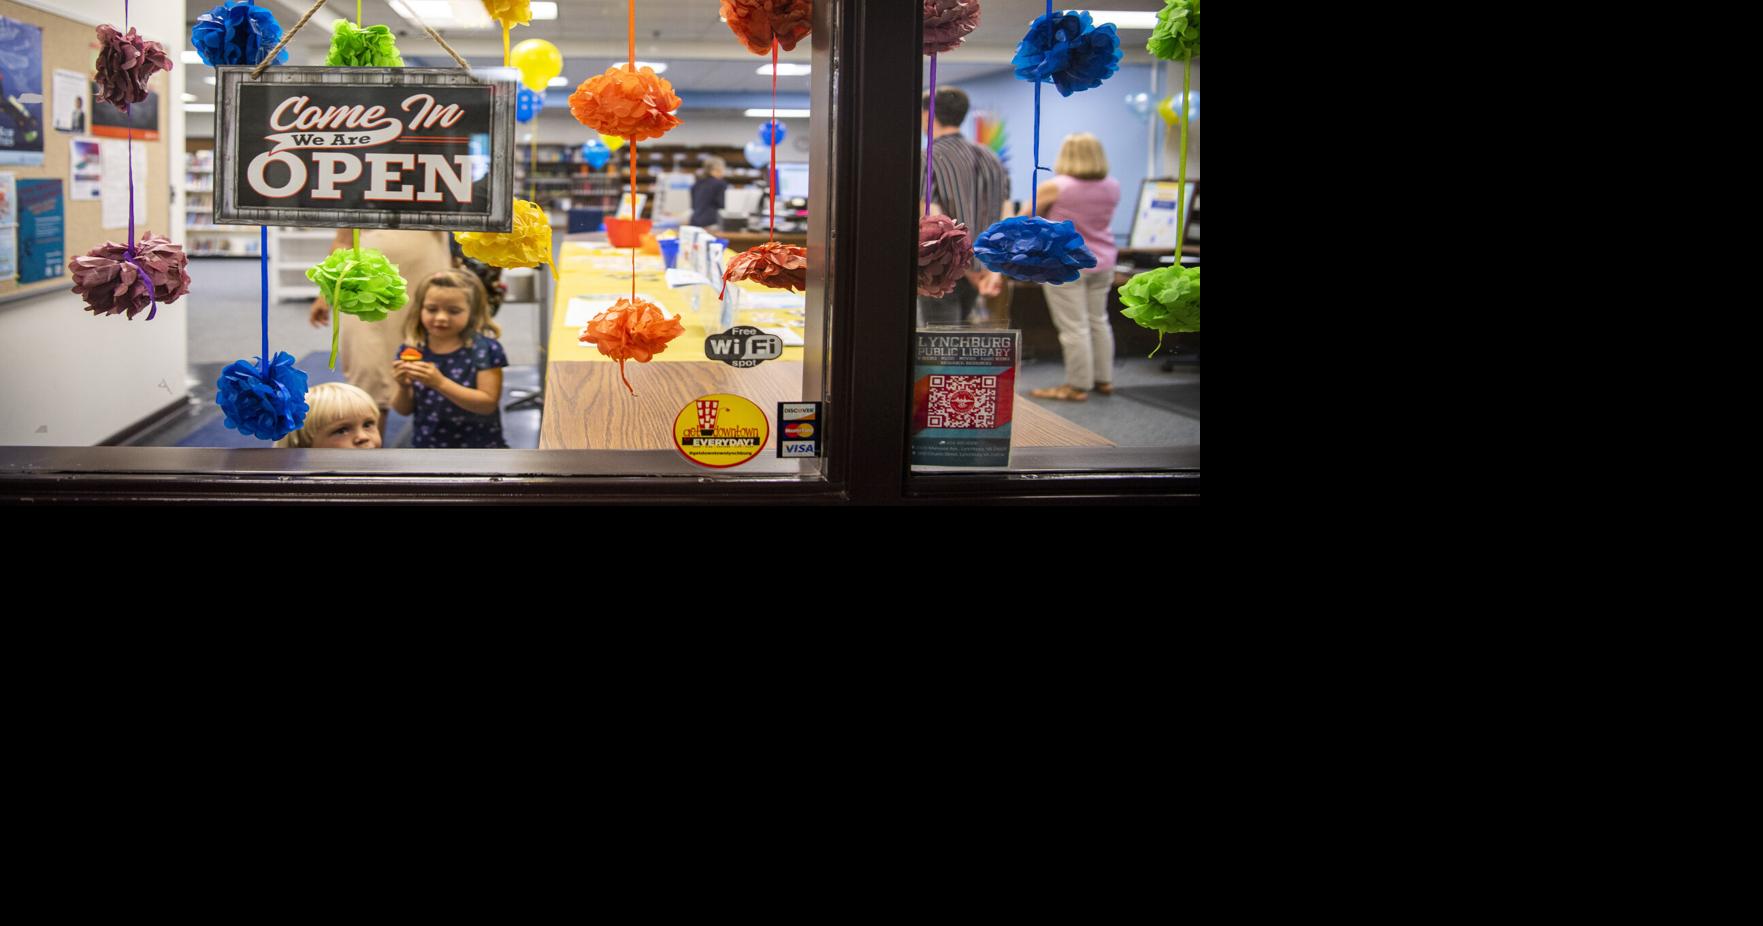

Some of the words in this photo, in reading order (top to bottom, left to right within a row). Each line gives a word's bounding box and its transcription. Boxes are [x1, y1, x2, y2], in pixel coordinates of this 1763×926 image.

[269, 95, 387, 131] Come
[401, 93, 465, 131] In
[291, 134, 325, 147] We
[332, 133, 371, 146] Are
[247, 150, 473, 203] OPEN
[732, 327, 757, 336] Free
[918, 336, 1011, 348] LYNCHBURG
[918, 347, 958, 356] PUBLIC
[962, 347, 1010, 356] LIBRARY
[732, 359, 757, 368] spot
[692, 438, 754, 447] EVERYDAY!
[785, 444, 814, 453] VISA
